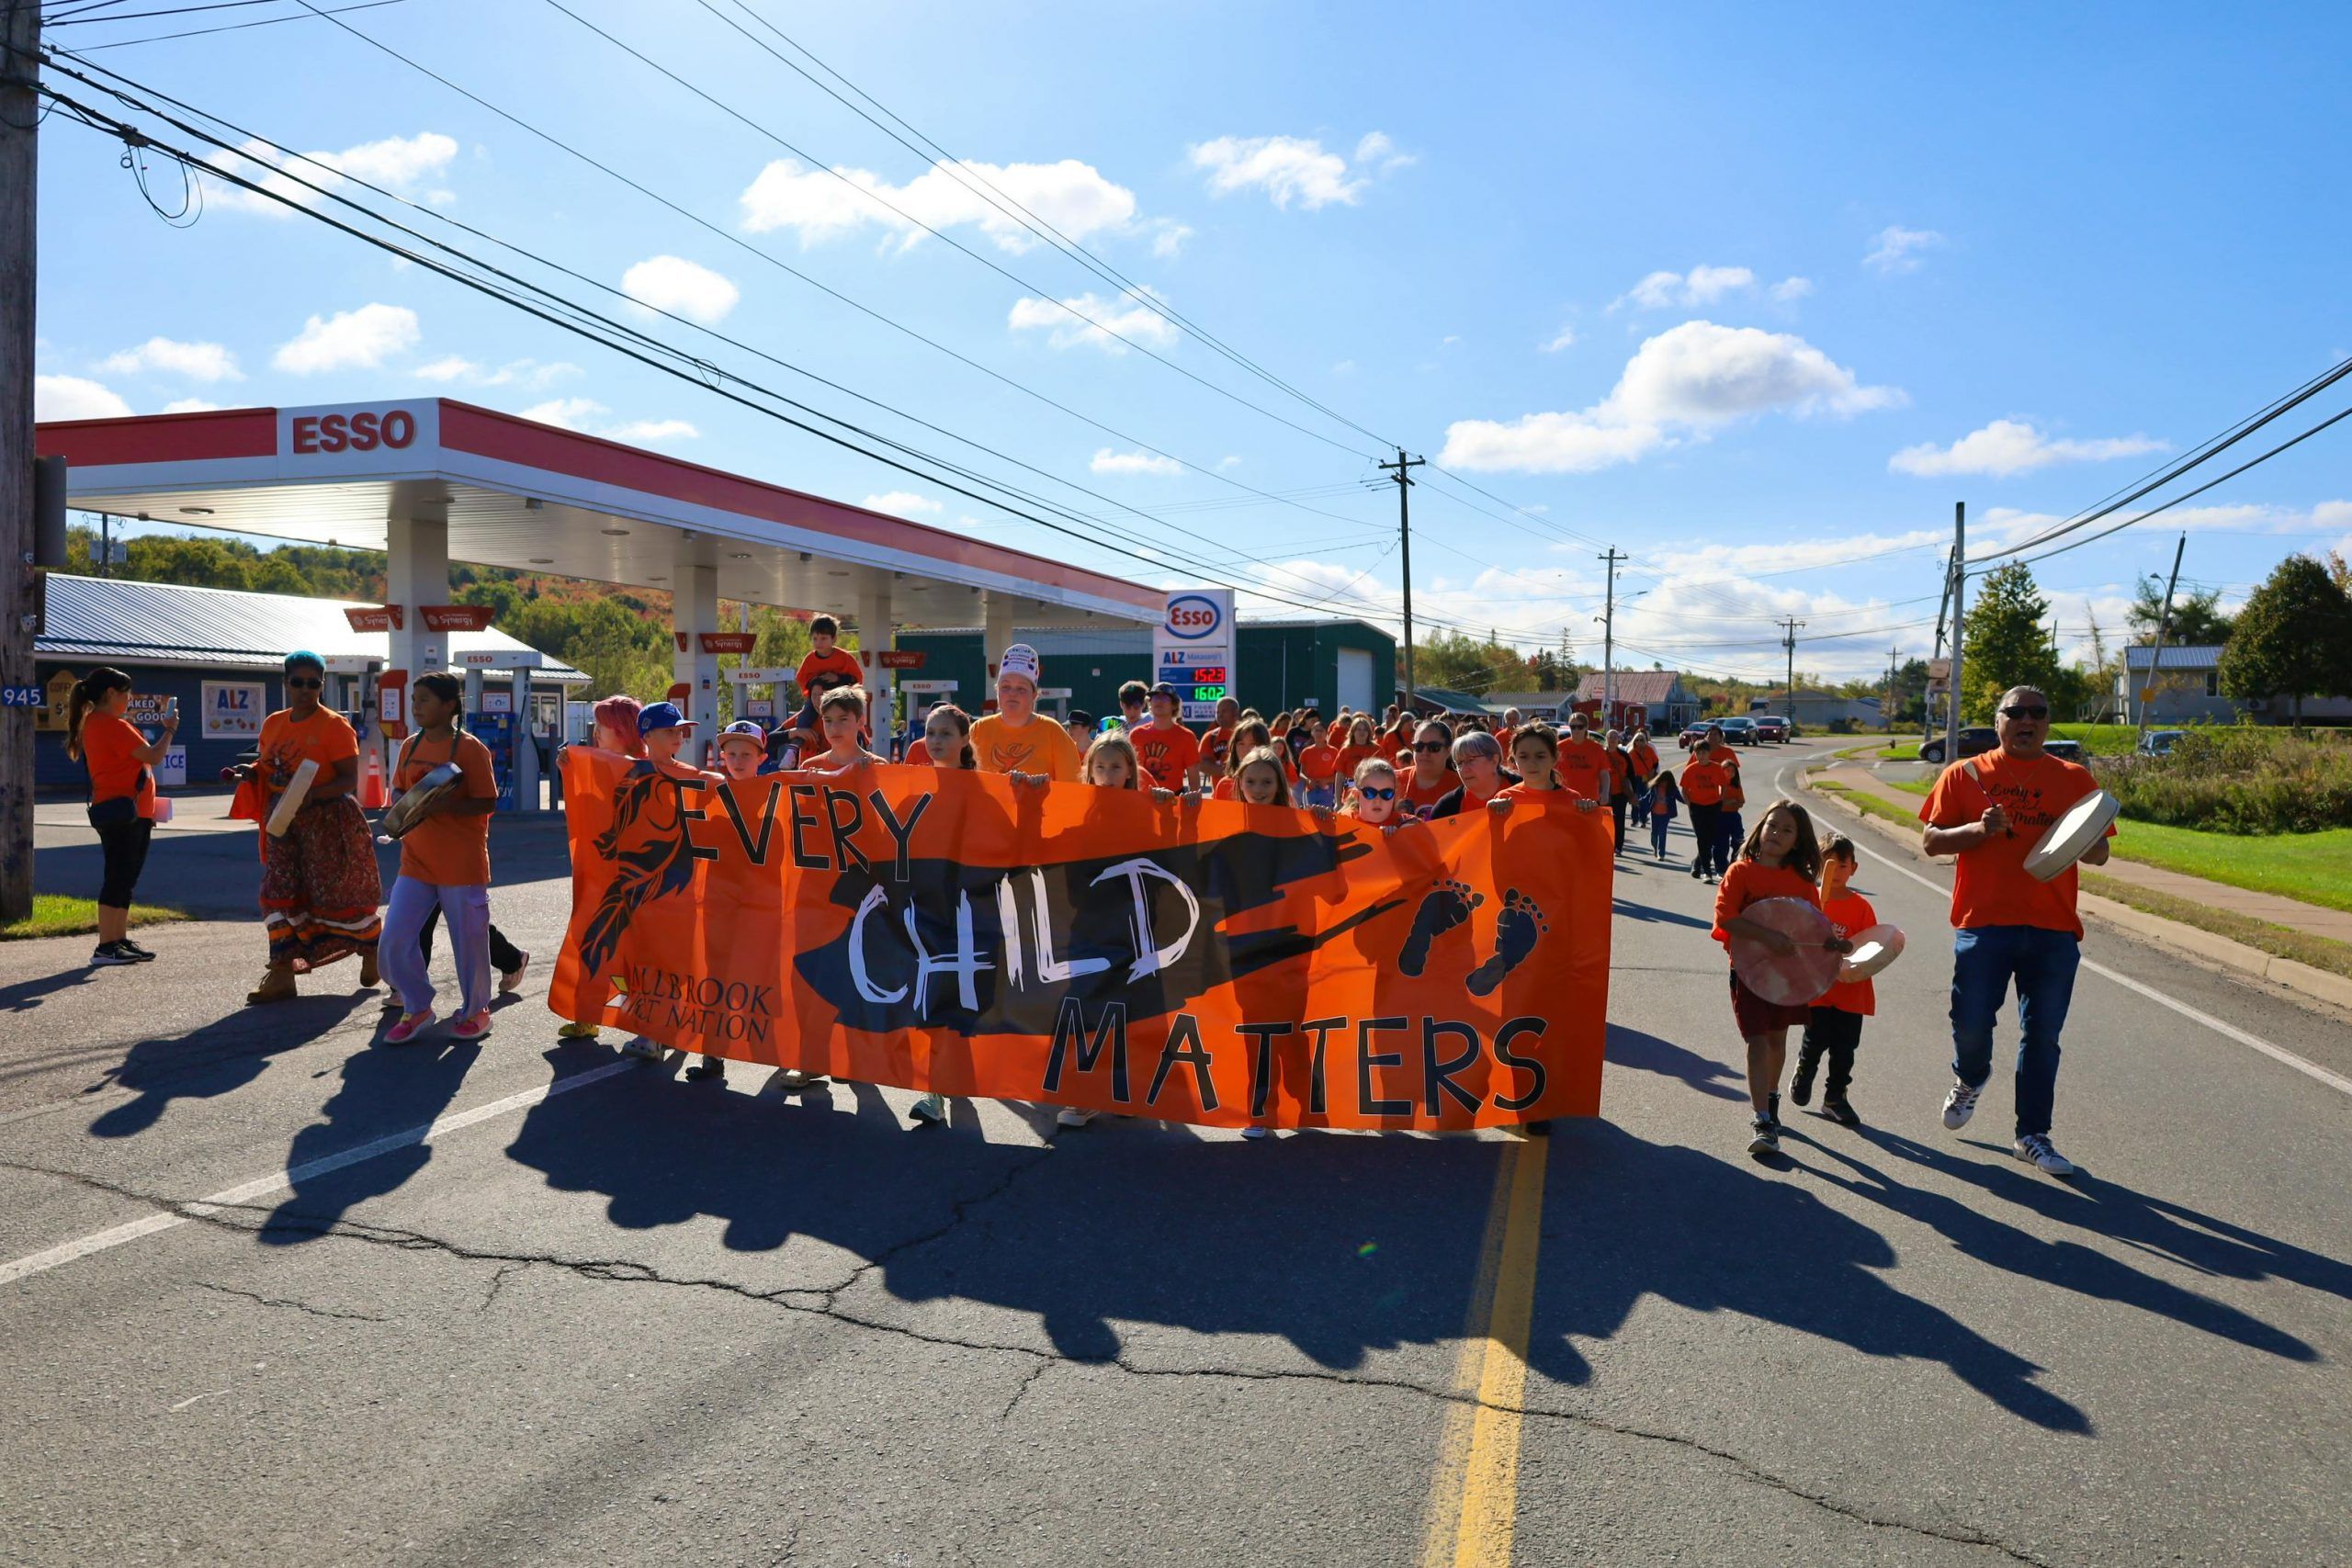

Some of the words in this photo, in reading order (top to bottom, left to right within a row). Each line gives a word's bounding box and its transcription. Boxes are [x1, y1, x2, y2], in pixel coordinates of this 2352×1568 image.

[292, 410, 417, 454] ESSO
[439, 615, 473, 626] Synergy
[1171, 607, 1213, 626] Esso
[468, 655, 493, 663] ESSO
[1164, 651, 1185, 664] ALZ
[4, 689, 41, 705] 945
[127, 699, 155, 709] AKED
[217, 689, 249, 709] ALZ
[137, 713, 166, 722] GOOD
[164, 754, 185, 769] ICE
[1989, 783, 2030, 803] Every
[676, 778, 933, 882] EVERY
[848, 858, 1200, 1021] CHILD
[665, 1005, 770, 1043] NATION
[1042, 997, 1548, 1118] MATTERS
